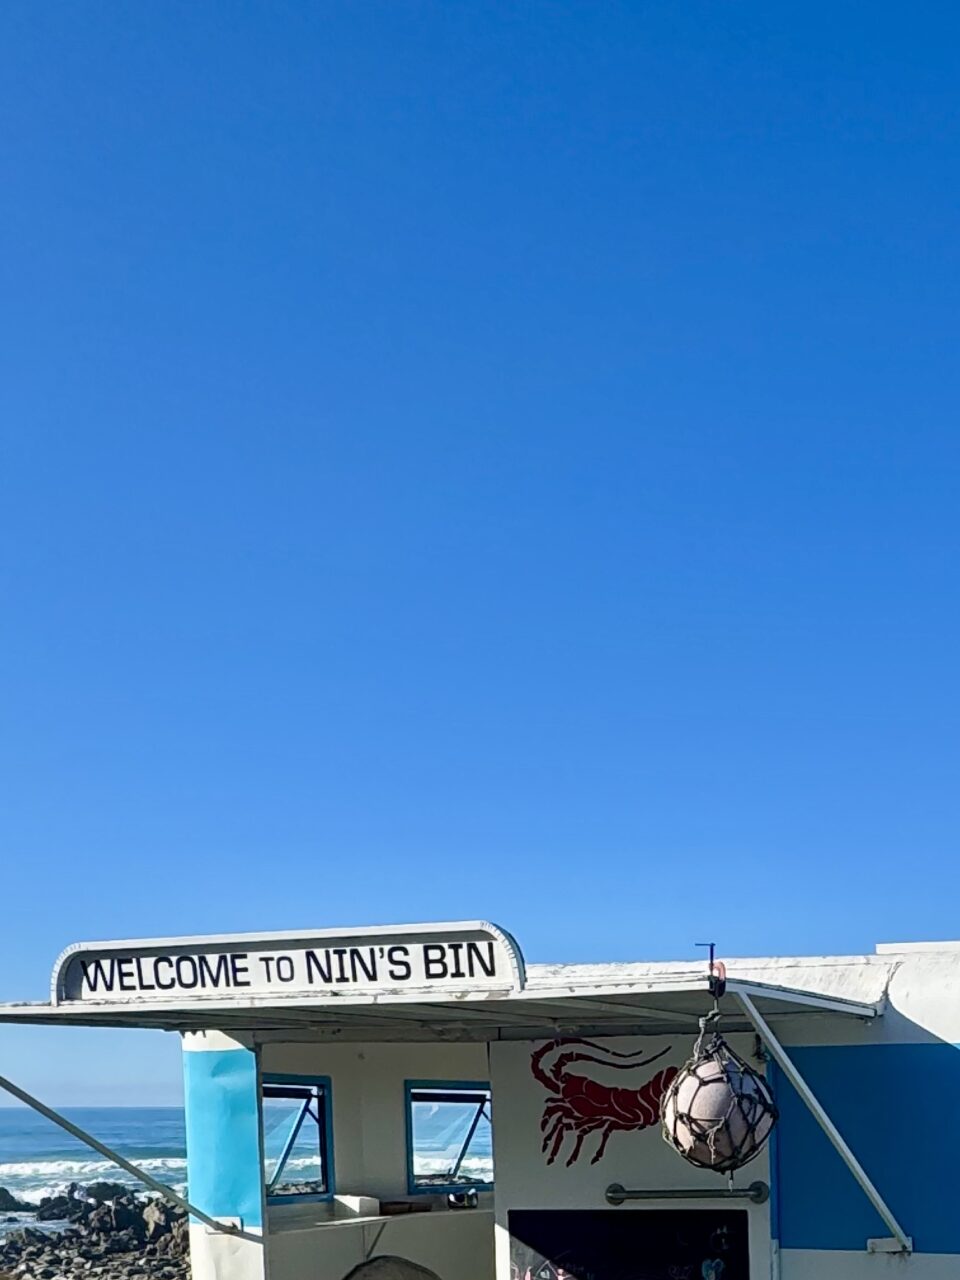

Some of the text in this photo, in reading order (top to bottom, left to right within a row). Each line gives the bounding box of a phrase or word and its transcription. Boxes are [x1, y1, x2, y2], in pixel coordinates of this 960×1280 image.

[82, 941, 496, 993] WELCOME TO NIN'S BIN
